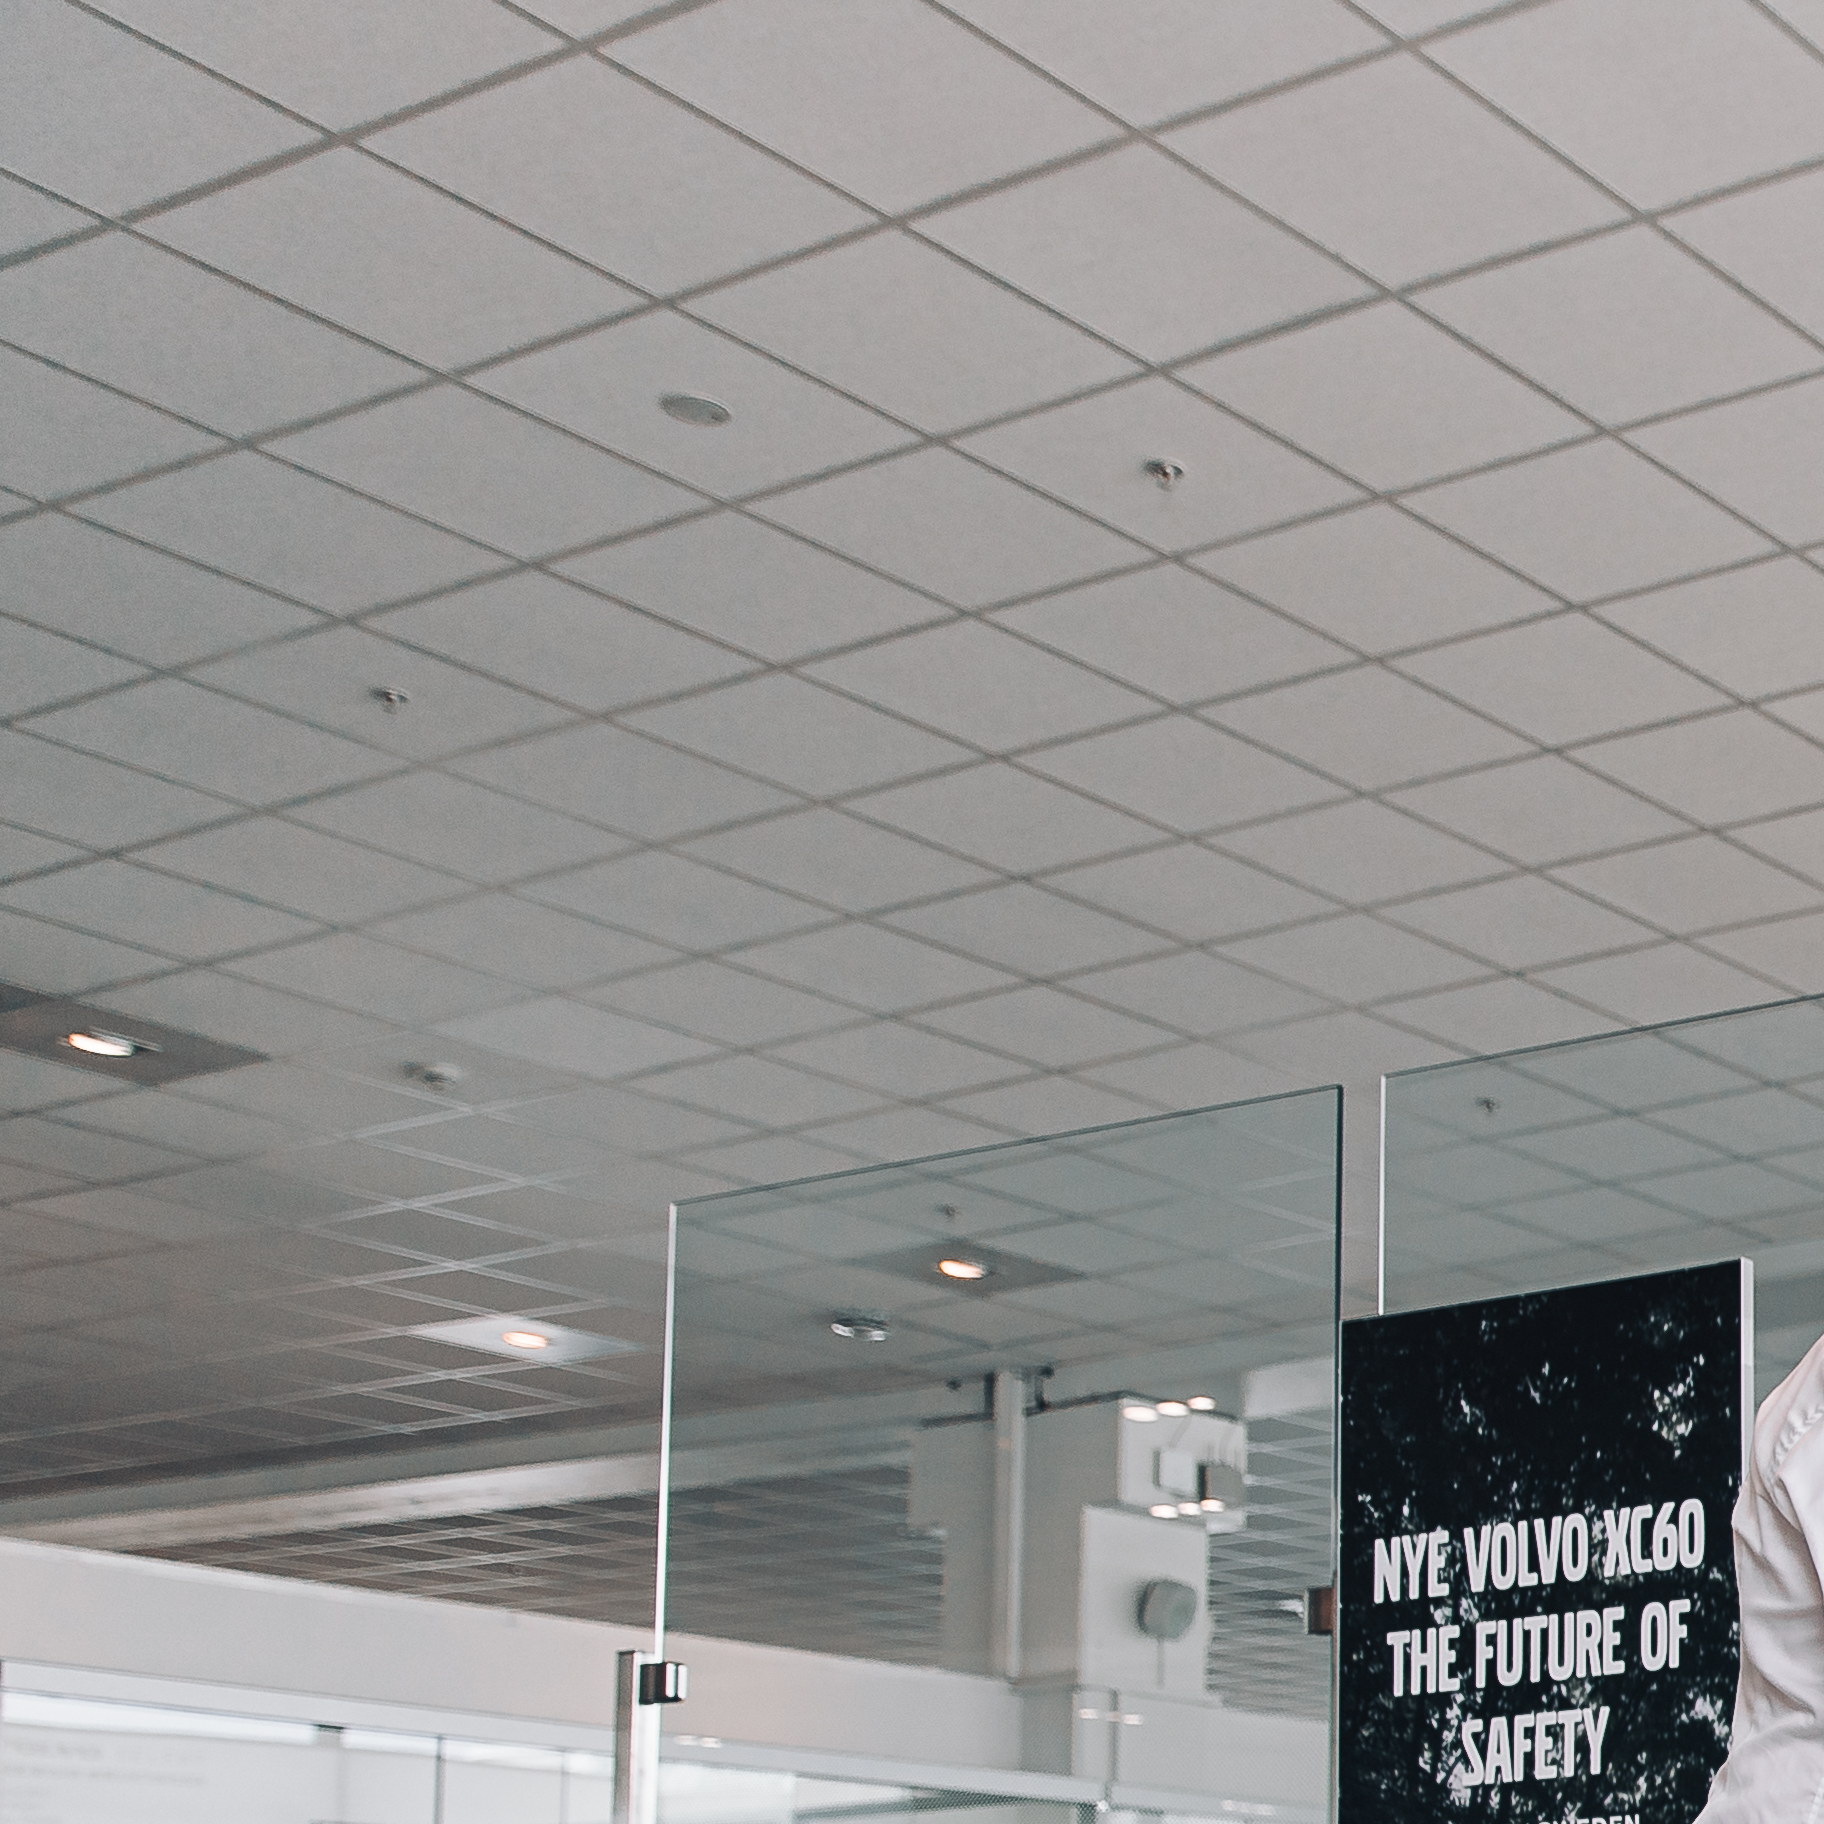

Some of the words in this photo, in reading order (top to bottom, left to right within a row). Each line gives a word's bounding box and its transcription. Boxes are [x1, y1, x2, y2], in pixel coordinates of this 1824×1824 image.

[1373, 1528, 1450, 1604] NYE
[1463, 1513, 1589, 1593] VOLVO
[1603, 1498, 1705, 1578] XC60
[1386, 1625, 1461, 1698] THE
[1475, 1606, 1625, 1689] FUTURE
[1640, 1599, 1691, 1671] OF
[1460, 1706, 1611, 1787] SAFETY
